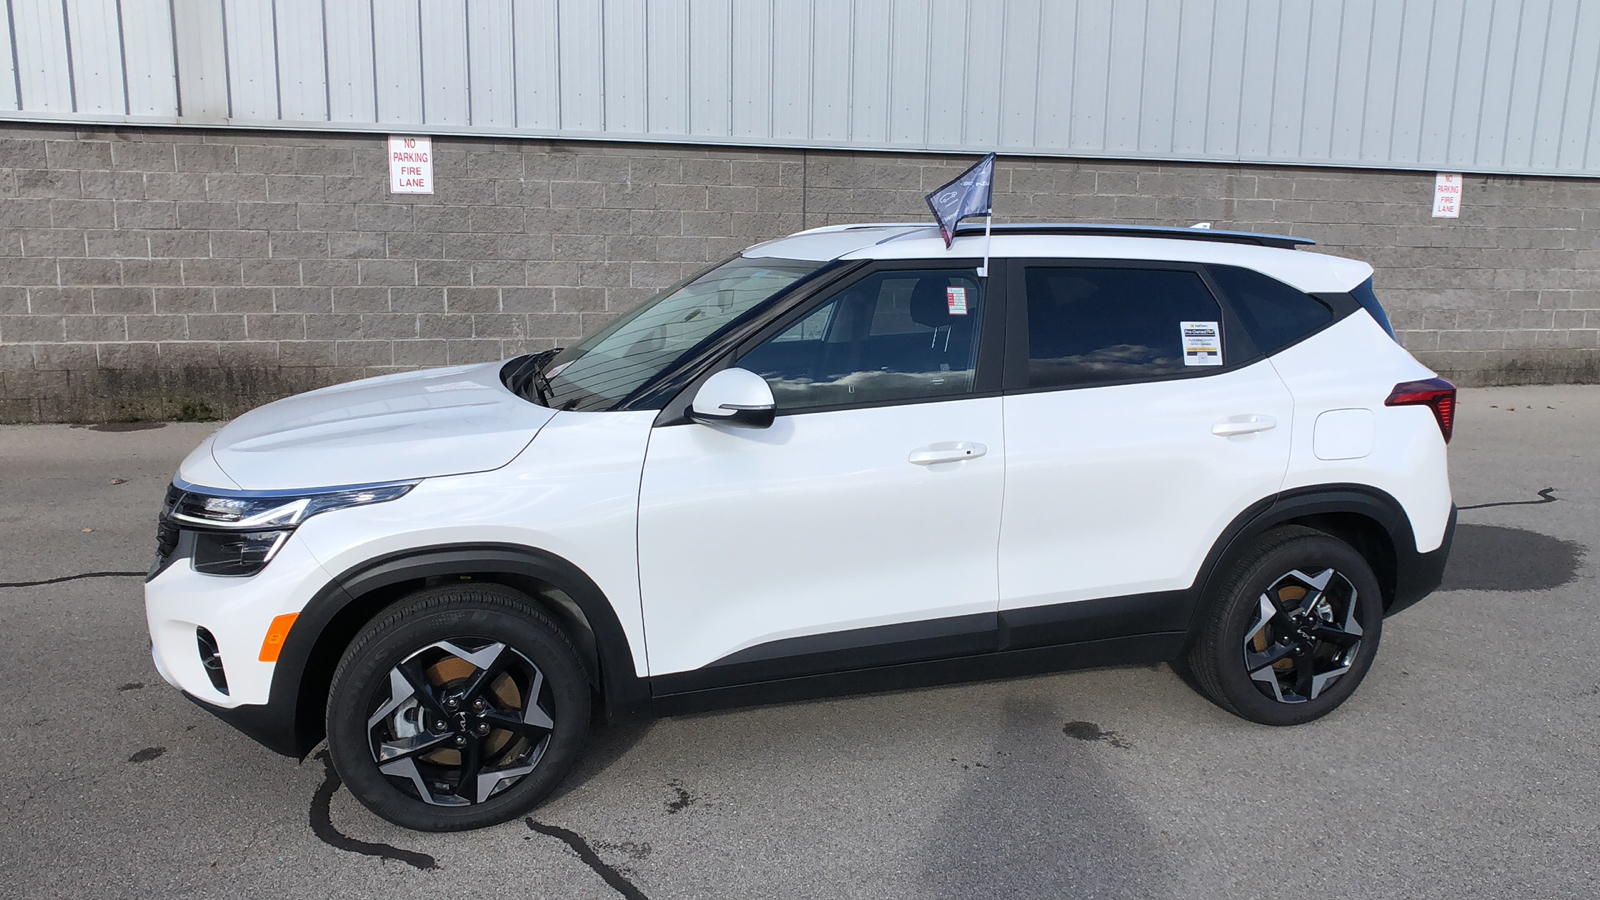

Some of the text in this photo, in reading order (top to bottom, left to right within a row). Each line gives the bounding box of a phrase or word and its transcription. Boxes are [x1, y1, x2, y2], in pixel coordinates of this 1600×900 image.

[404, 138, 416, 148] NO
[393, 152, 428, 163] PARKING
[401, 166, 422, 175] FIRE
[399, 178, 425, 187] LANE
[1445, 174, 1453, 182] NO
[1438, 185, 1459, 193] PARKING
